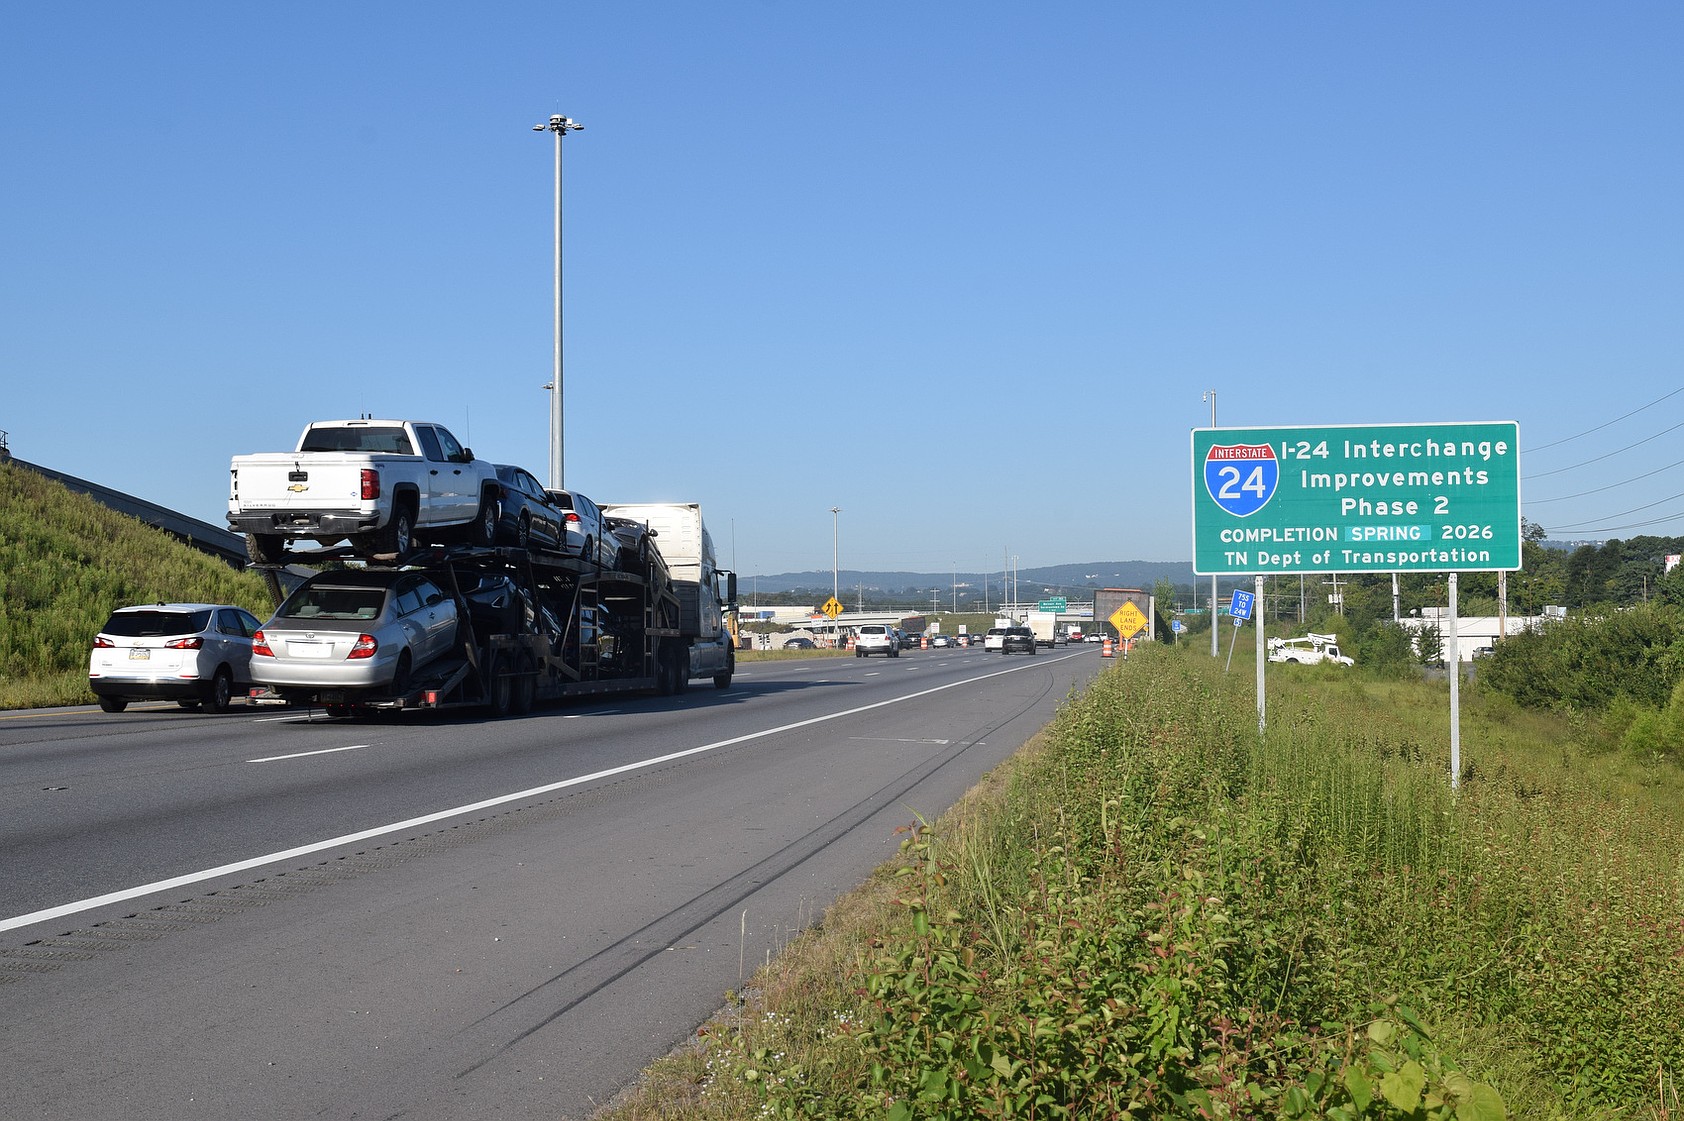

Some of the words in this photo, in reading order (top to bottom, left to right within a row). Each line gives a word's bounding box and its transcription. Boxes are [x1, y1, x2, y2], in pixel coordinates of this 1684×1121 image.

[1214, 448, 1268, 459] INTERSTATE
[1281, 440, 1330, 460] I-24
[1344, 438, 1508, 462] Interchange
[1217, 465, 1266, 499] 24
[1301, 466, 1489, 492] Improvements
[1341, 497, 1419, 516] Phase
[1433, 495, 1449, 515] 2
[1219, 527, 1338, 543] COMPLETION
[1351, 525, 1421, 541] SPRING
[1441, 524, 1494, 540] 2026
[1224, 551, 1248, 566] TN
[1257, 550, 1301, 568] Dept
[1311, 550, 1331, 564] of
[1341, 548, 1490, 567] Transportation
[1238, 600, 1247, 609] TO
